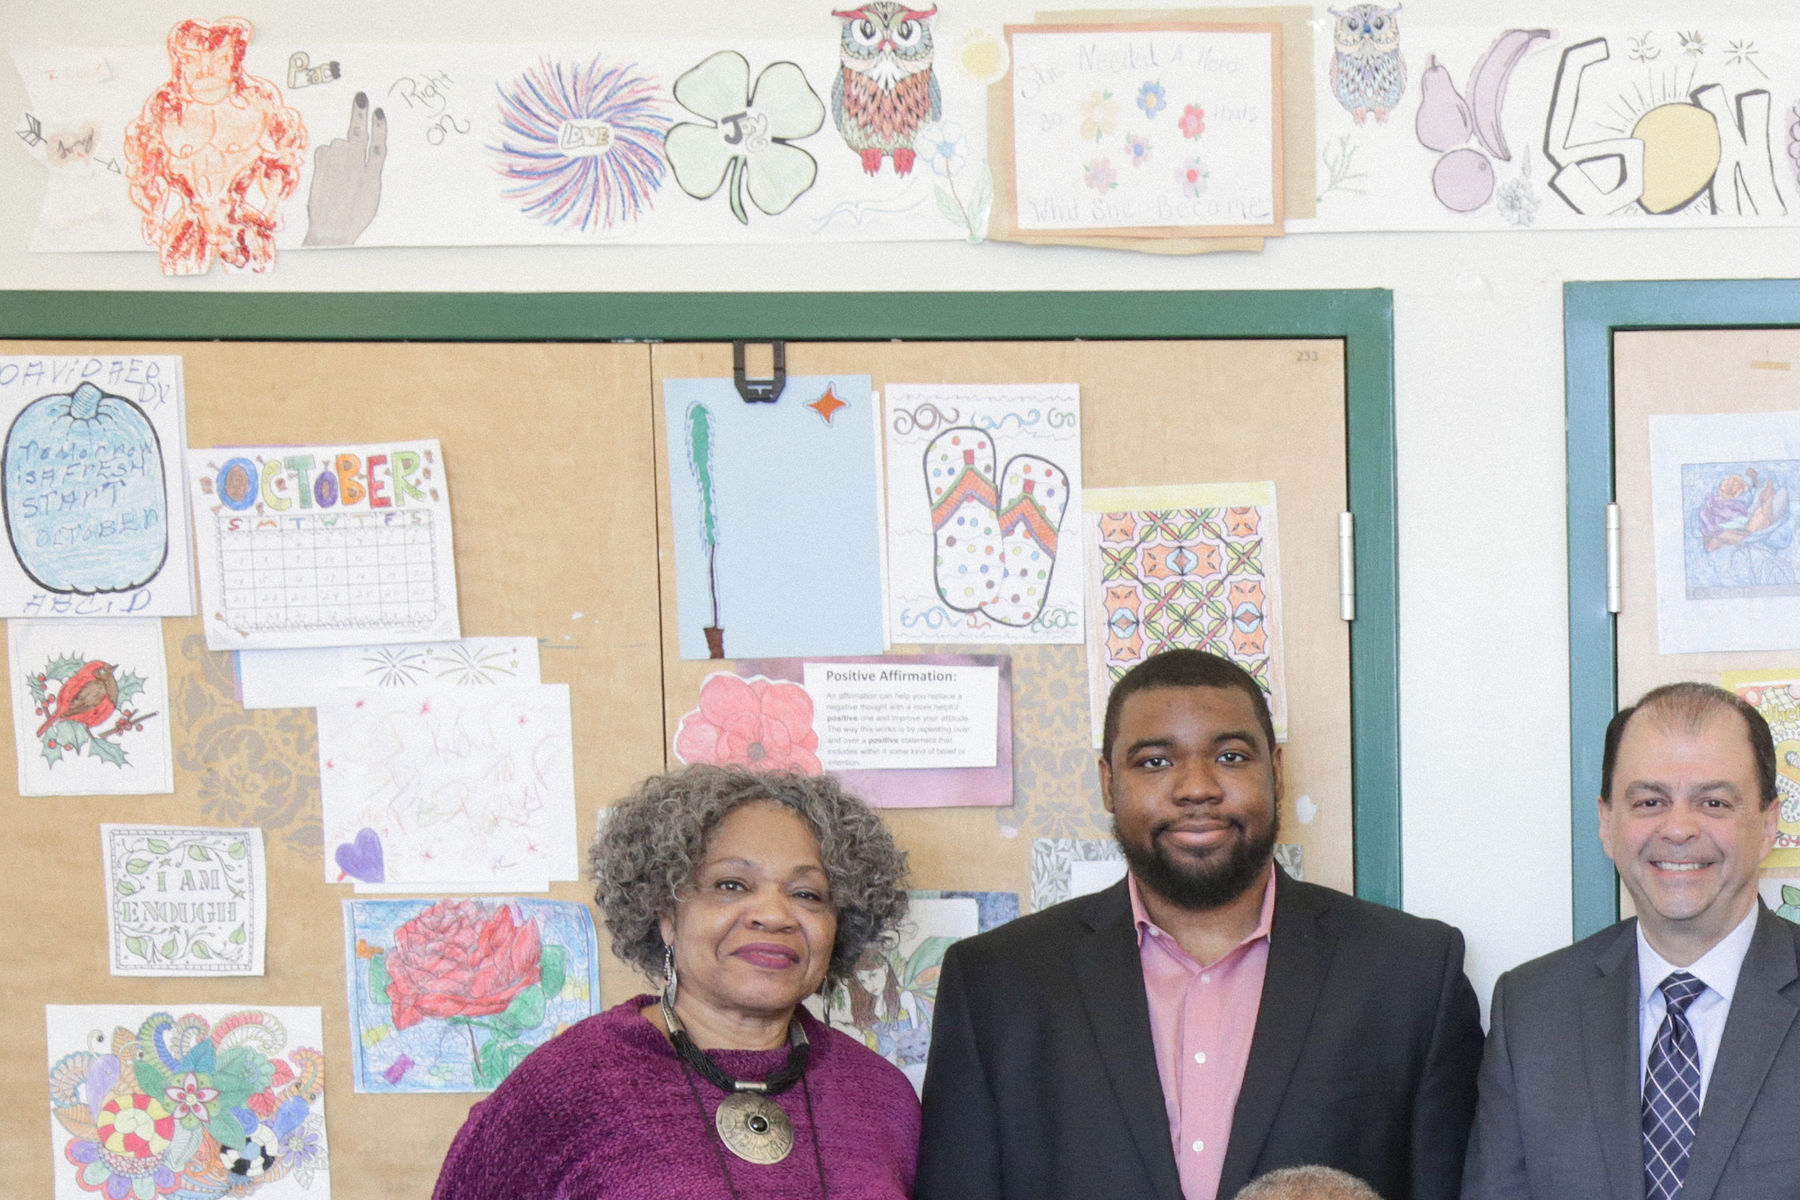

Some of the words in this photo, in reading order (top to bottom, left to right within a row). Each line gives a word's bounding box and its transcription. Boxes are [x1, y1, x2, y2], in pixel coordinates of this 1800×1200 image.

[1296, 350, 1318, 361] 233
[216, 451, 426, 512] OCTOBER
[826, 670, 876, 682] Positive
[879, 670, 957, 682] Affirmation:
[156, 871, 167, 892] I
[179, 869, 220, 891] AM
[122, 901, 237, 923] ENOUGH
